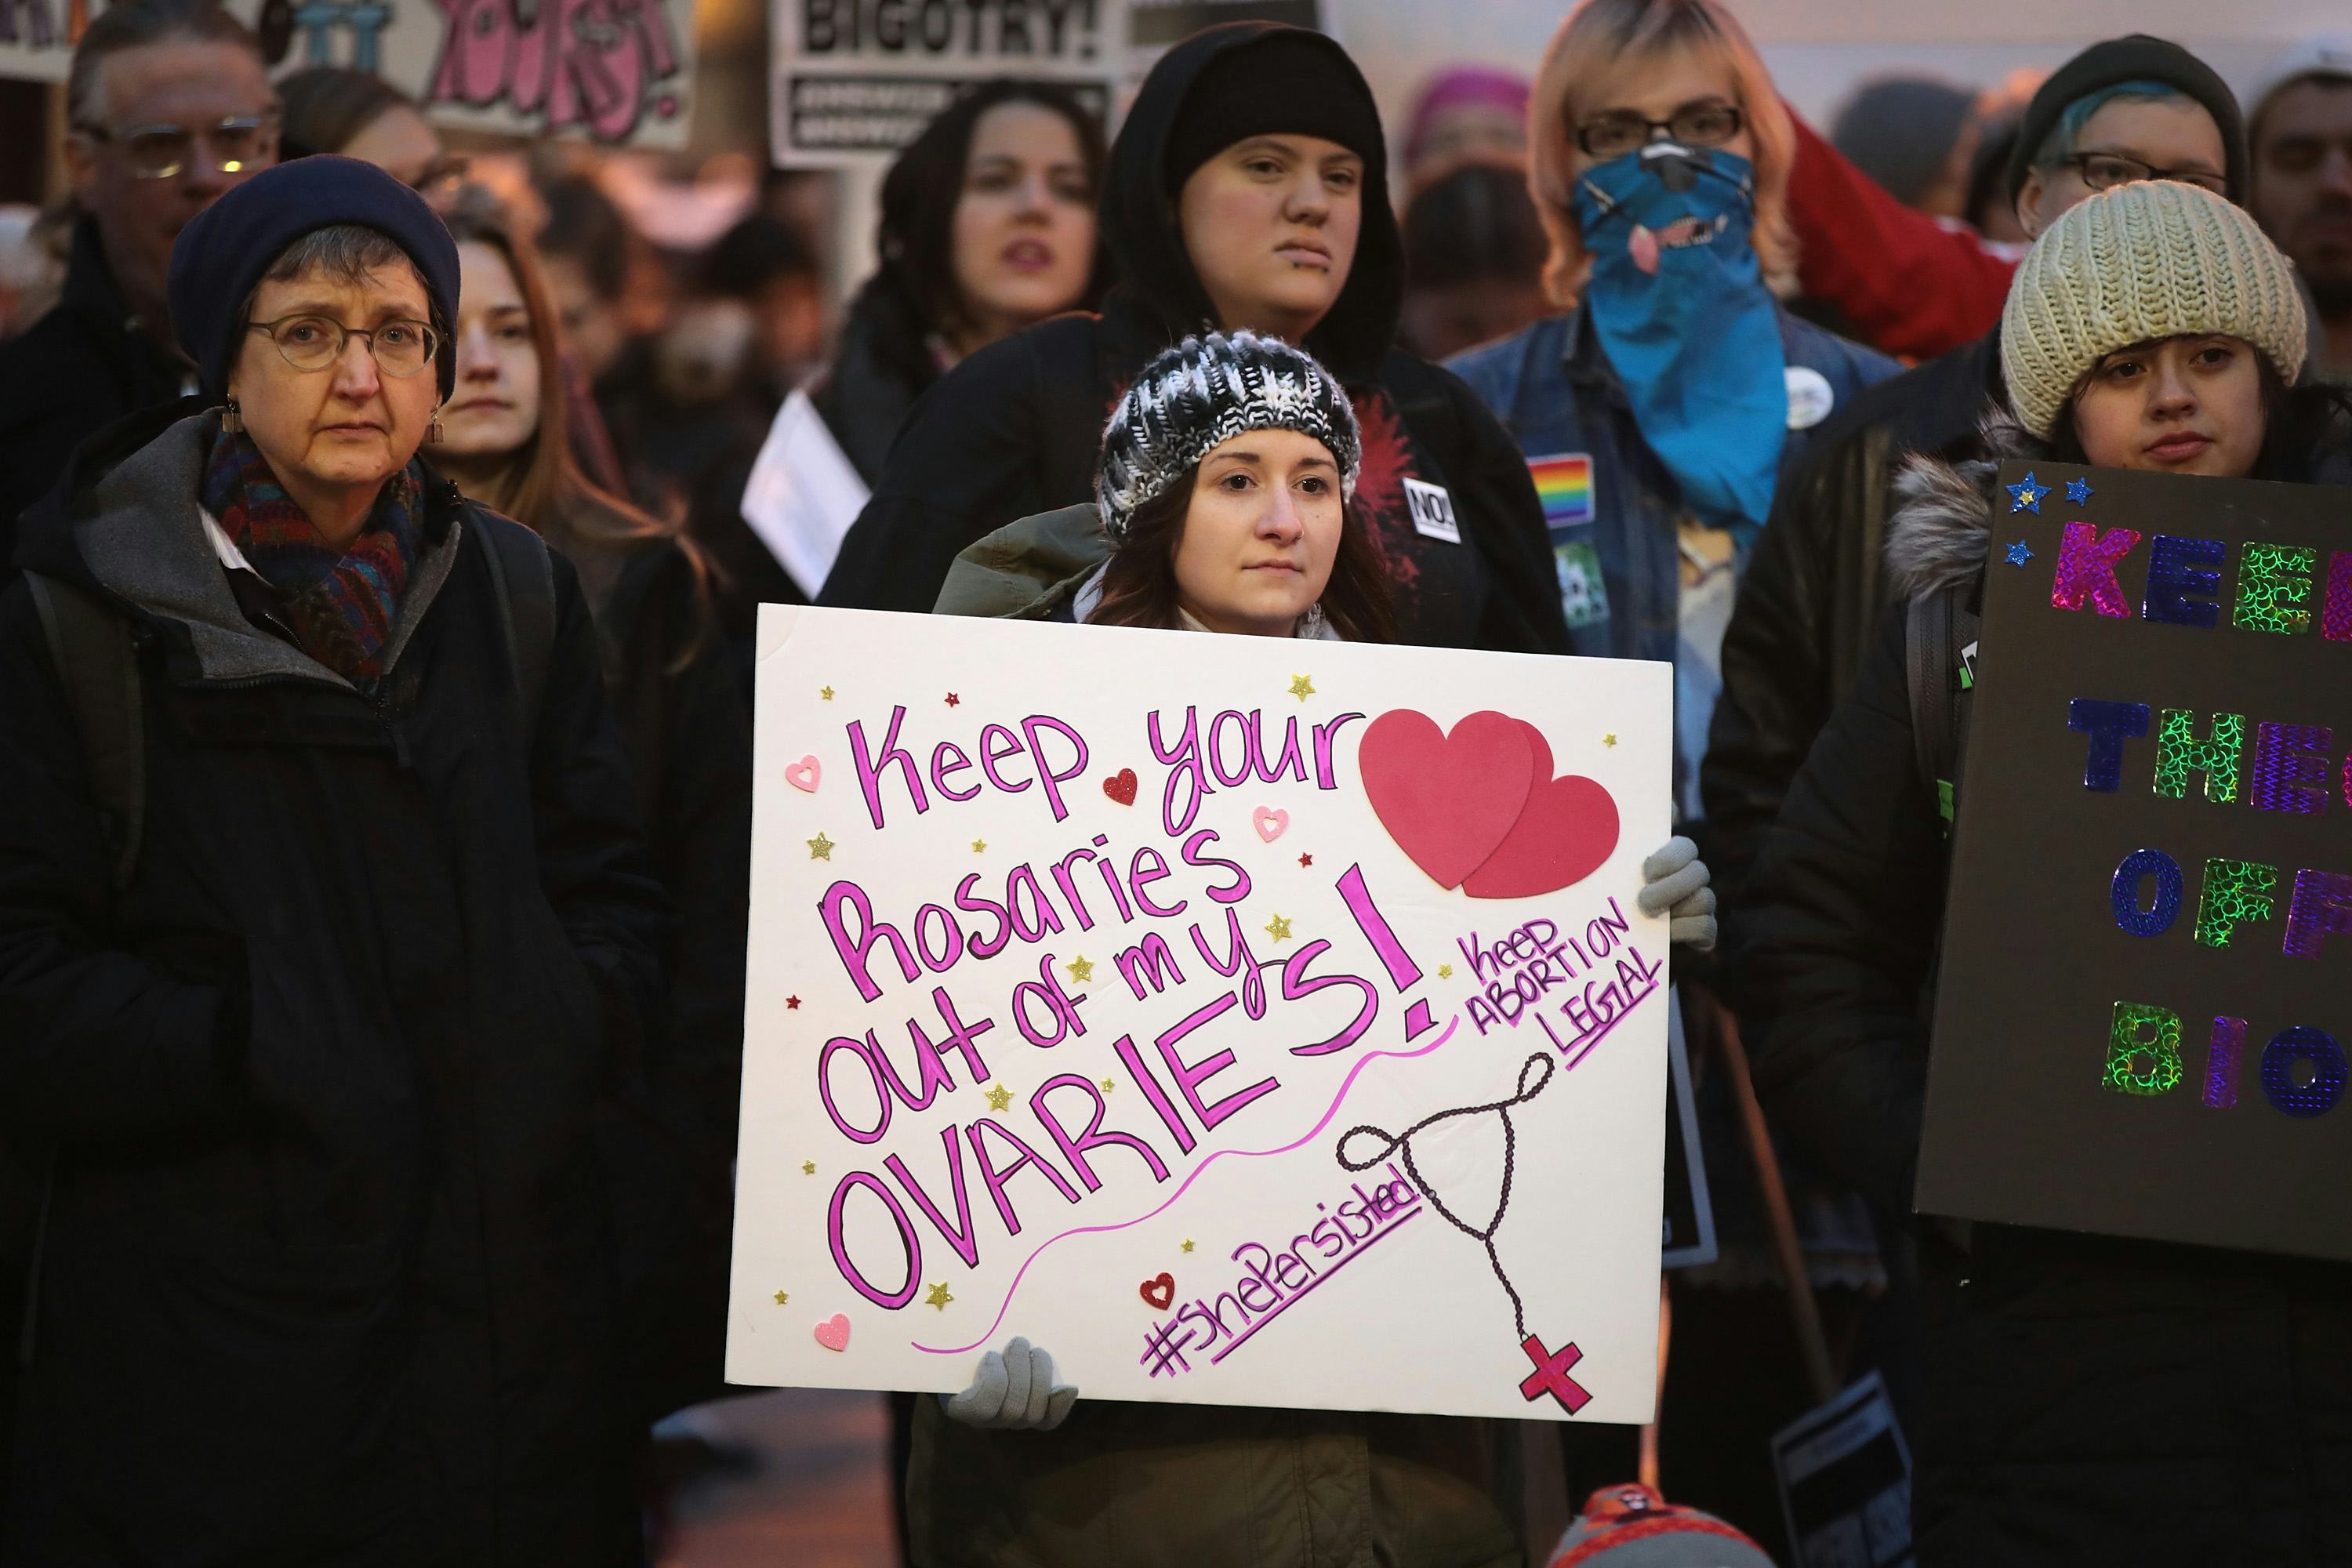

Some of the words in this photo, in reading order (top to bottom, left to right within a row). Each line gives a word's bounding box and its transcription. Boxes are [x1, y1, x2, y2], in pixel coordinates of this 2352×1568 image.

[804, 0, 1097, 56] BIGOTRY!
[846, 705, 1089, 829] Keep
[1147, 705, 1367, 837] your
[2067, 697, 2352, 815] THE
[817, 829, 1252, 1004] Rosaries
[2110, 848, 2352, 960] OFF
[1012, 953, 1087, 1048] of
[1464, 895, 1630, 1036] ABORTION
[1534, 946, 1664, 1056] LEGAL
[2102, 1000, 2349, 1118] BIO
